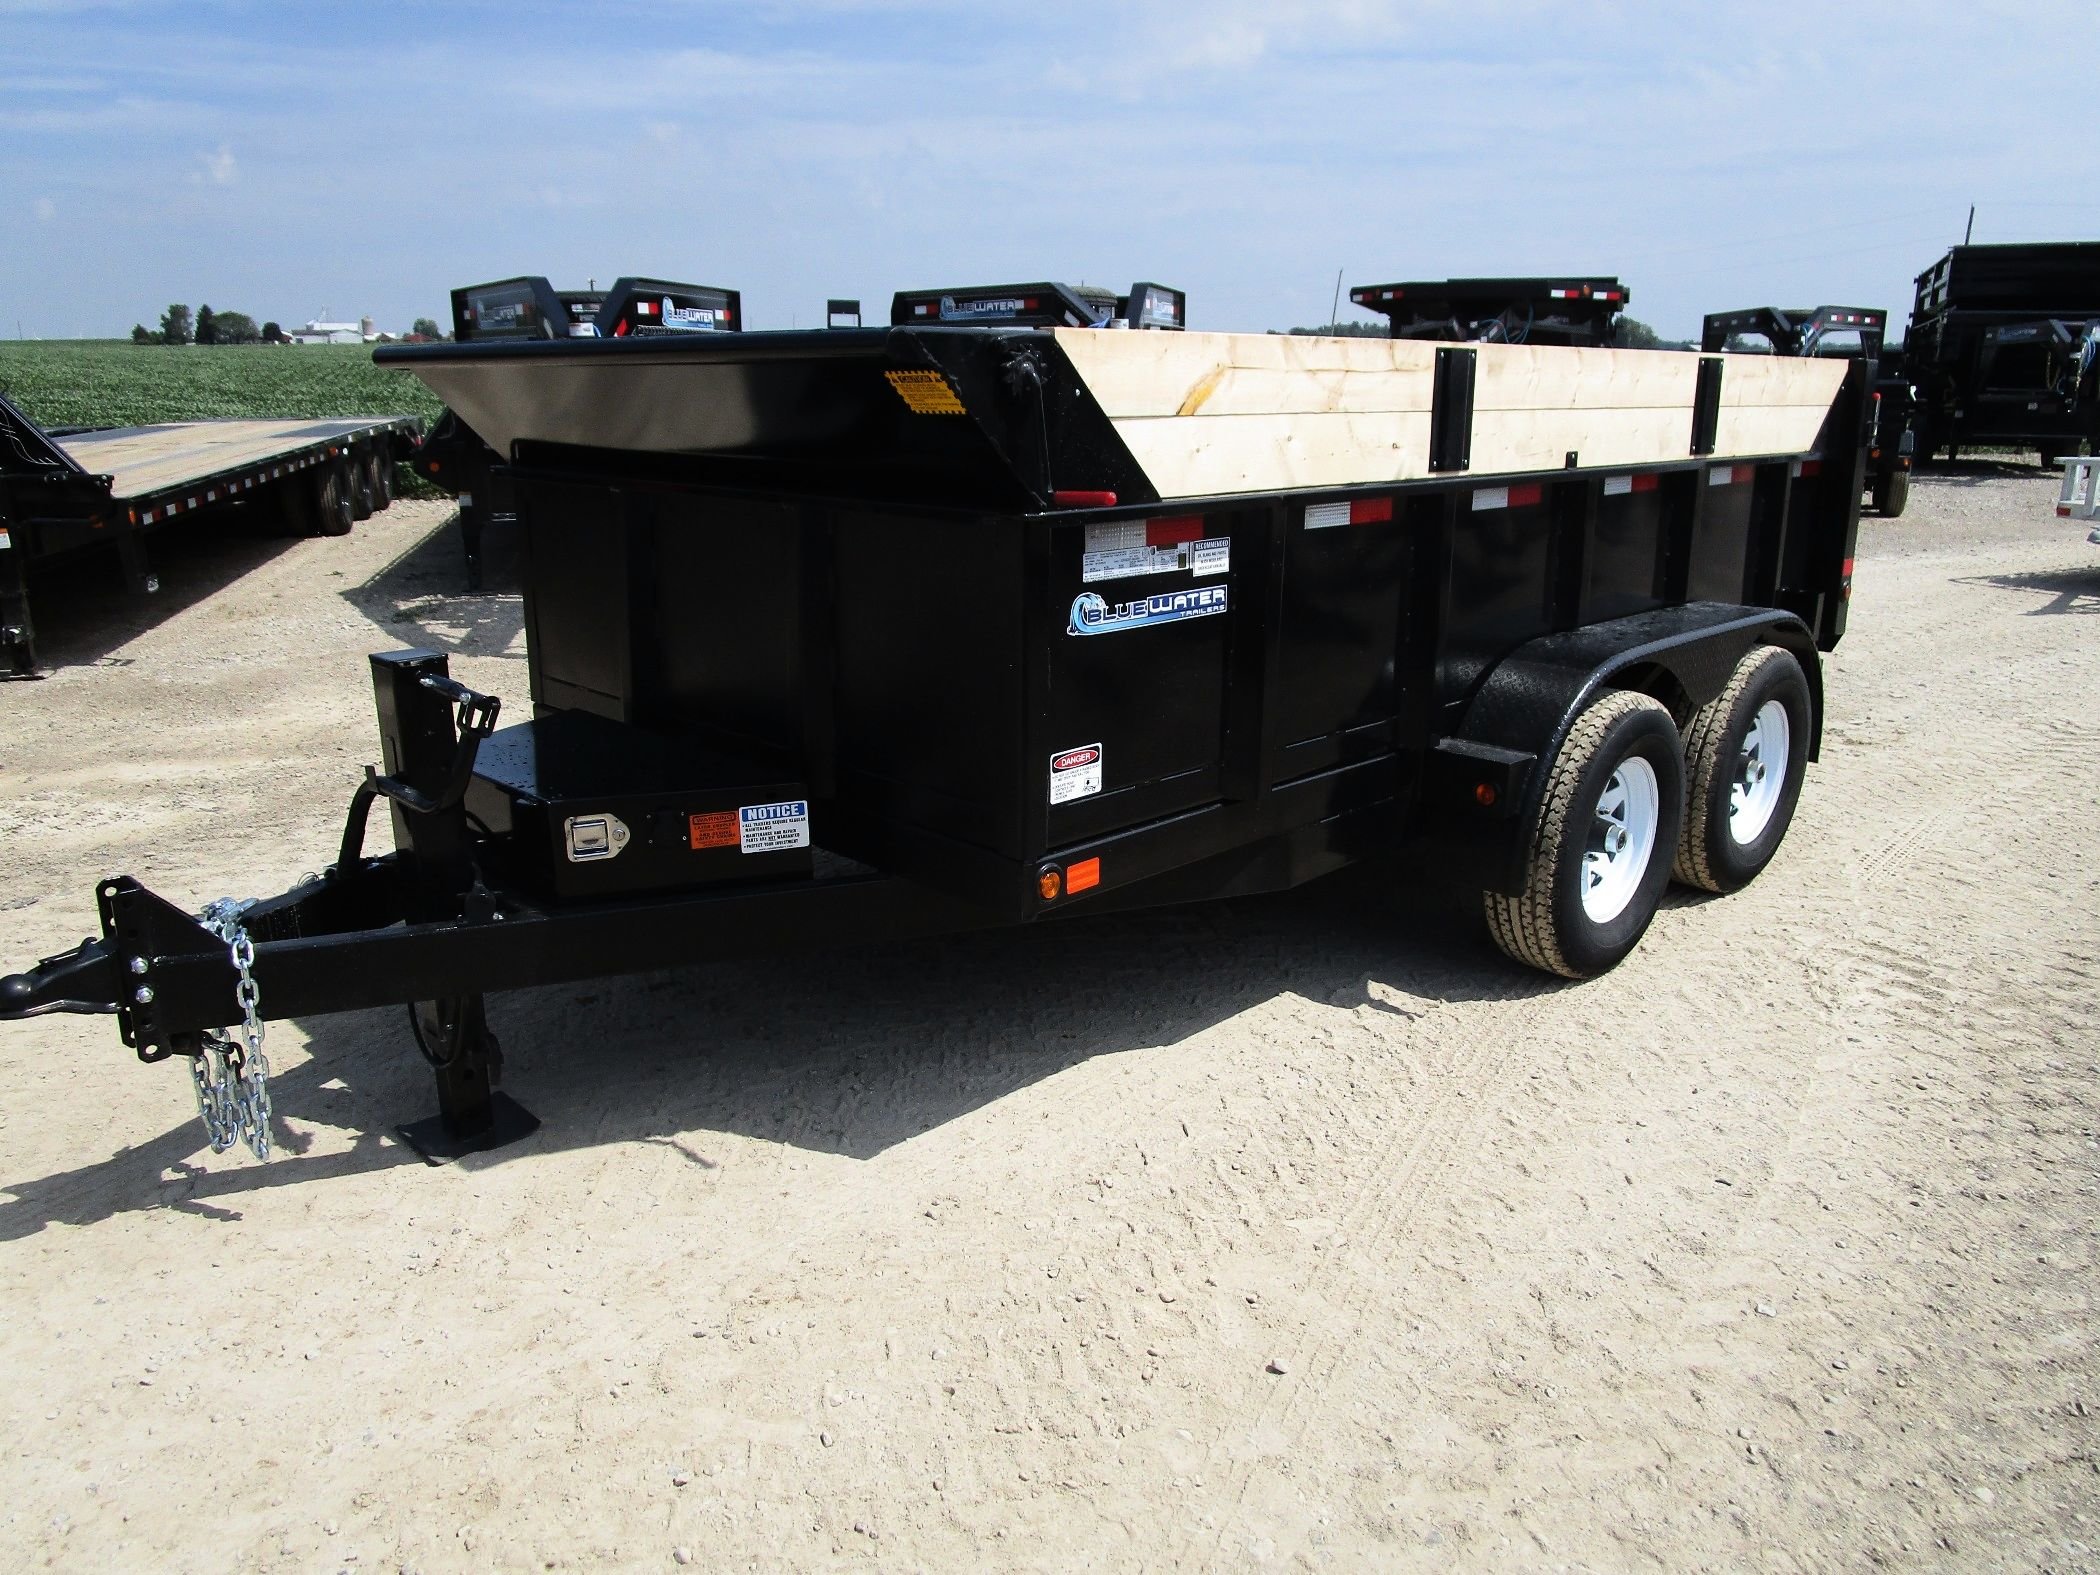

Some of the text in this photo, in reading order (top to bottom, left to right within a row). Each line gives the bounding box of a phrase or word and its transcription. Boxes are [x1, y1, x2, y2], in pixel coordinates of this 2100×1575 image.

[947, 301, 1014, 312] BLUEWATER
[669, 308, 713, 322] BLUEWATER
[1195, 539, 1229, 550] RECOMMENDED
[1088, 589, 1226, 623] BLUEWATER
[1180, 604, 1225, 617] TRAILERS
[1061, 752, 1091, 767] DANGER
[696, 814, 733, 823] WARNING
[747, 804, 800, 821] NOTICE
